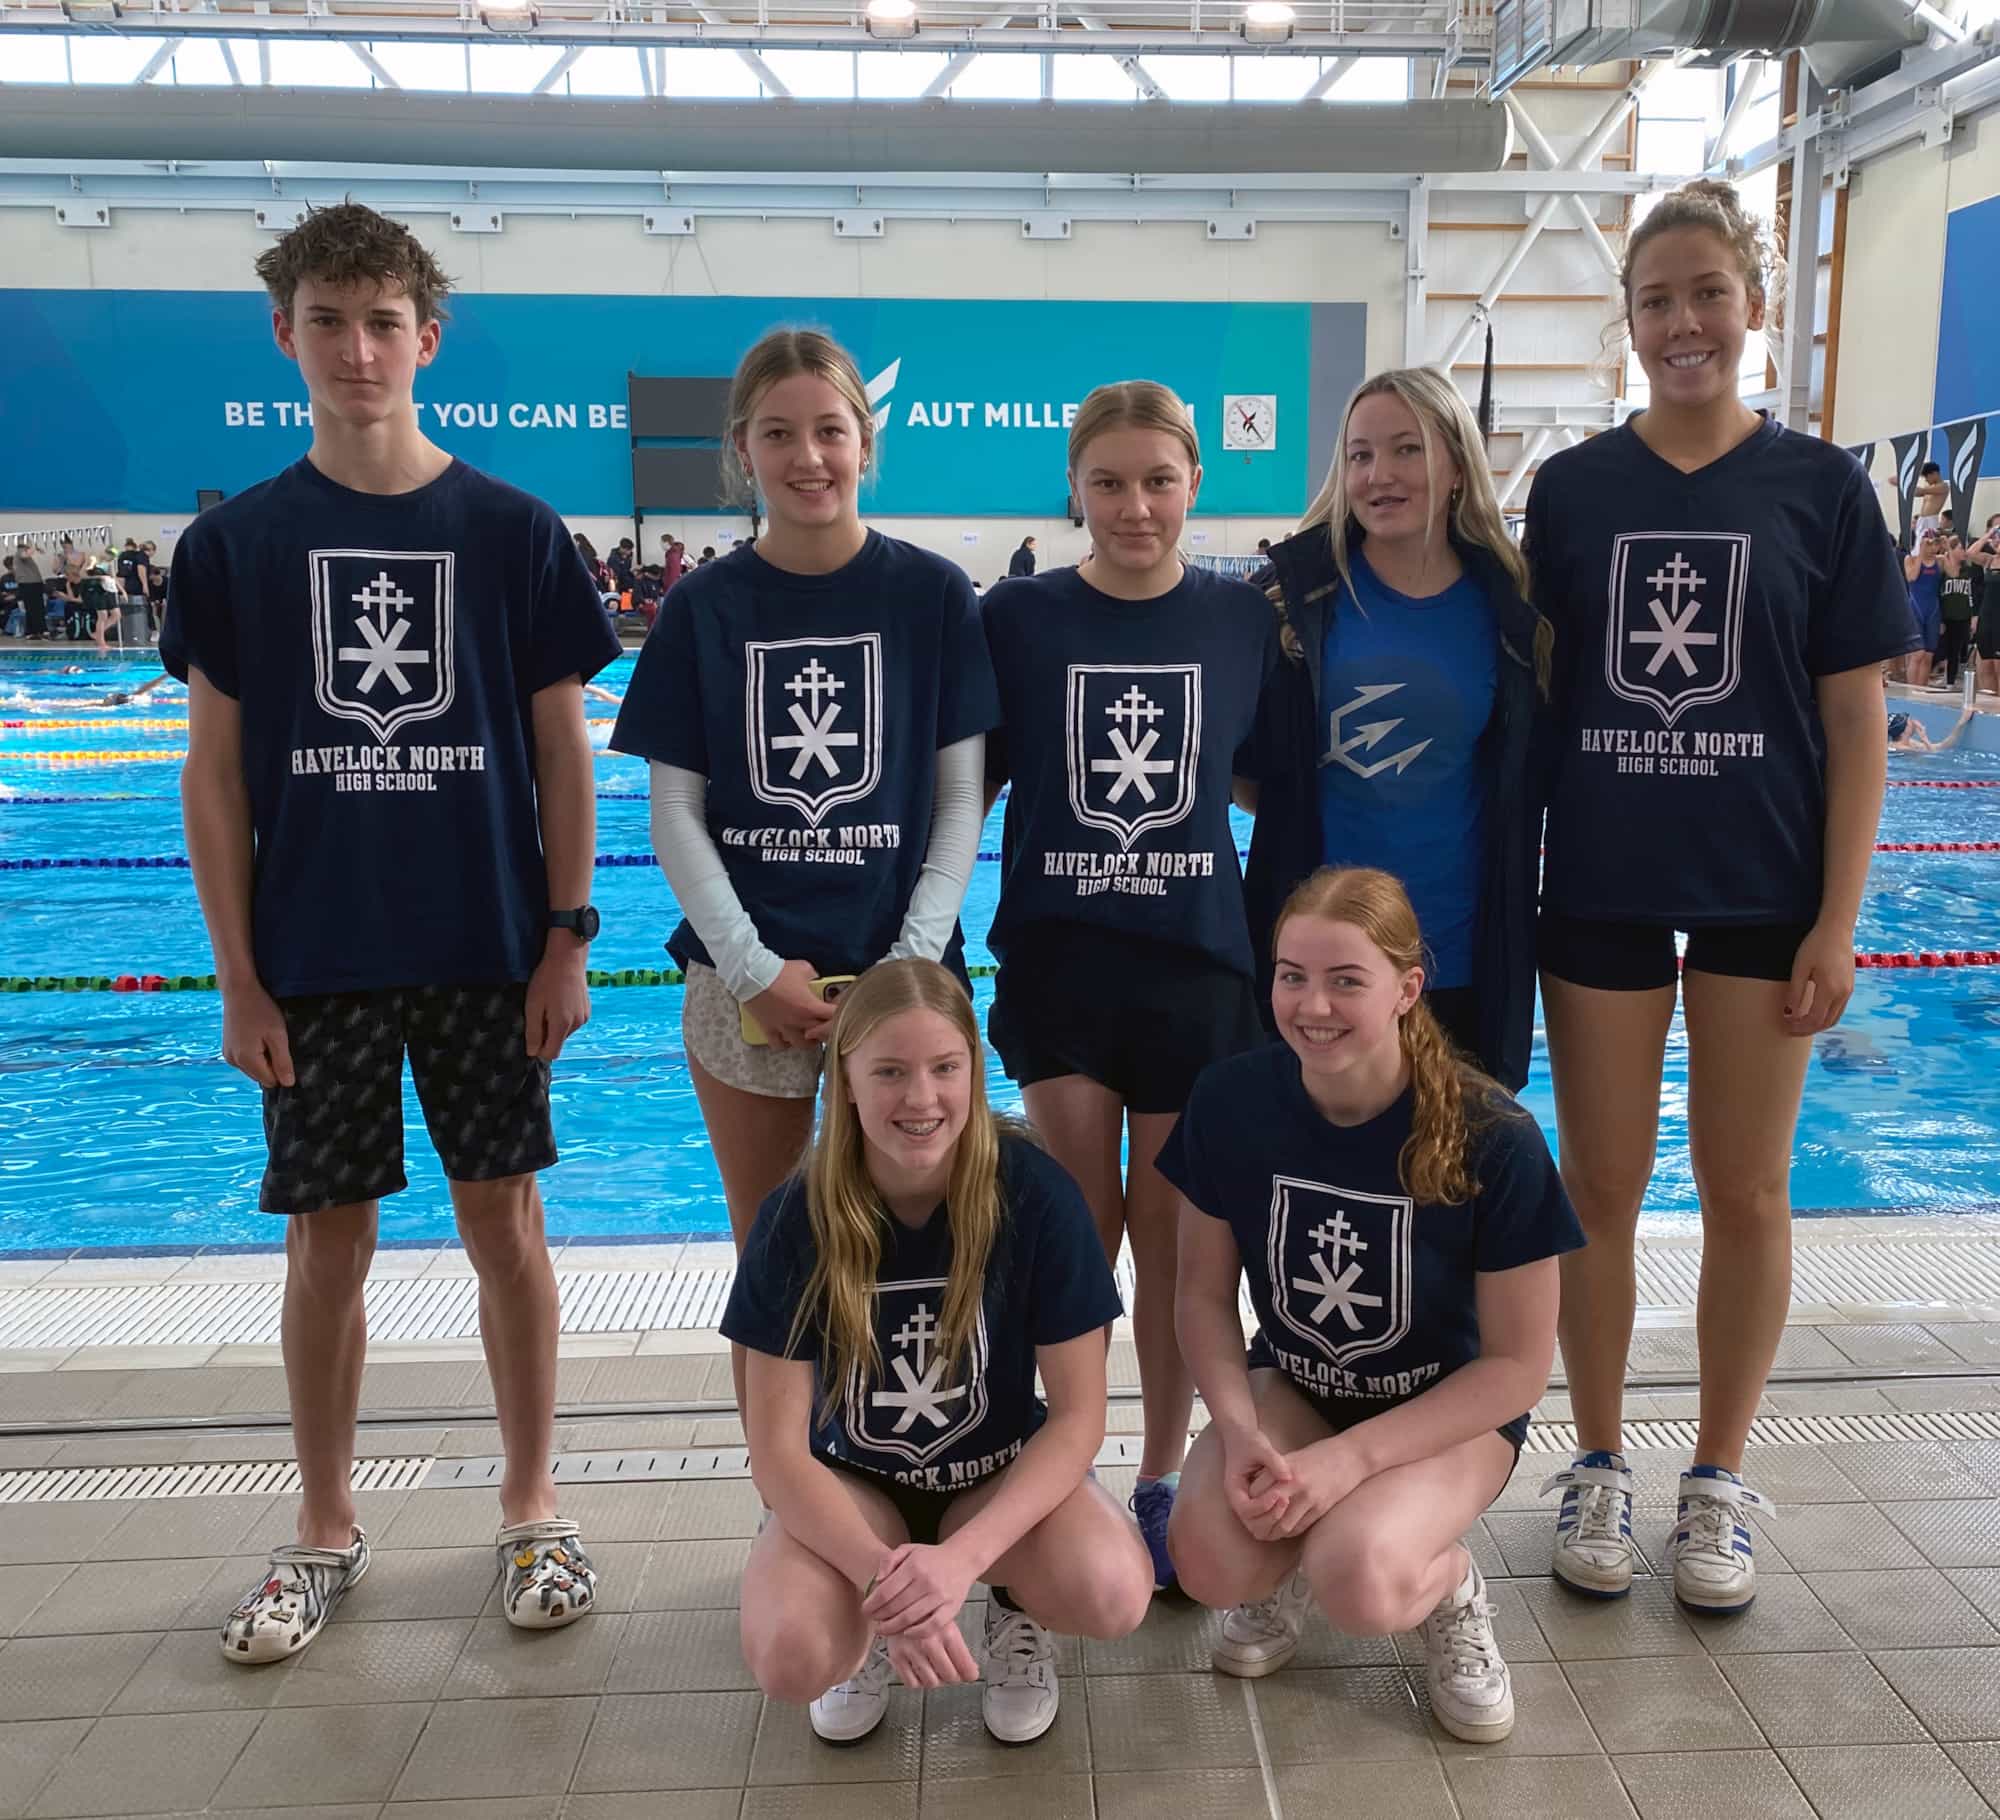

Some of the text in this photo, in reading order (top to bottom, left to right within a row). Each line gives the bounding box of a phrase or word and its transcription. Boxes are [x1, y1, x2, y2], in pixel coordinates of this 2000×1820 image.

[223, 401, 265, 427] BE
[272, 401, 315, 427] TH
[432, 402, 499, 428] YOU
[508, 403, 577, 428] CAN
[588, 404, 627, 428] BE
[906, 401, 975, 428] AUT
[1581, 728, 1765, 757] HAVELOCK NORTH
[291, 746, 485, 775] HAVELOCK NORTH
[1617, 756, 1719, 776] HIGH SCHOOL
[335, 773, 438, 792] HIGH SCHOOL
[721, 824, 901, 849] HAVELOCK NORTH
[761, 848, 865, 865] HIGH SCHOOL
[1043, 852, 1215, 877] HAVELOCK NORTH
[1075, 876, 1168, 896] HIGH SCHOOL
[1269, 1341, 1441, 1396] VELOCK NORTH
[948, 1438, 1023, 1484] NORTH
